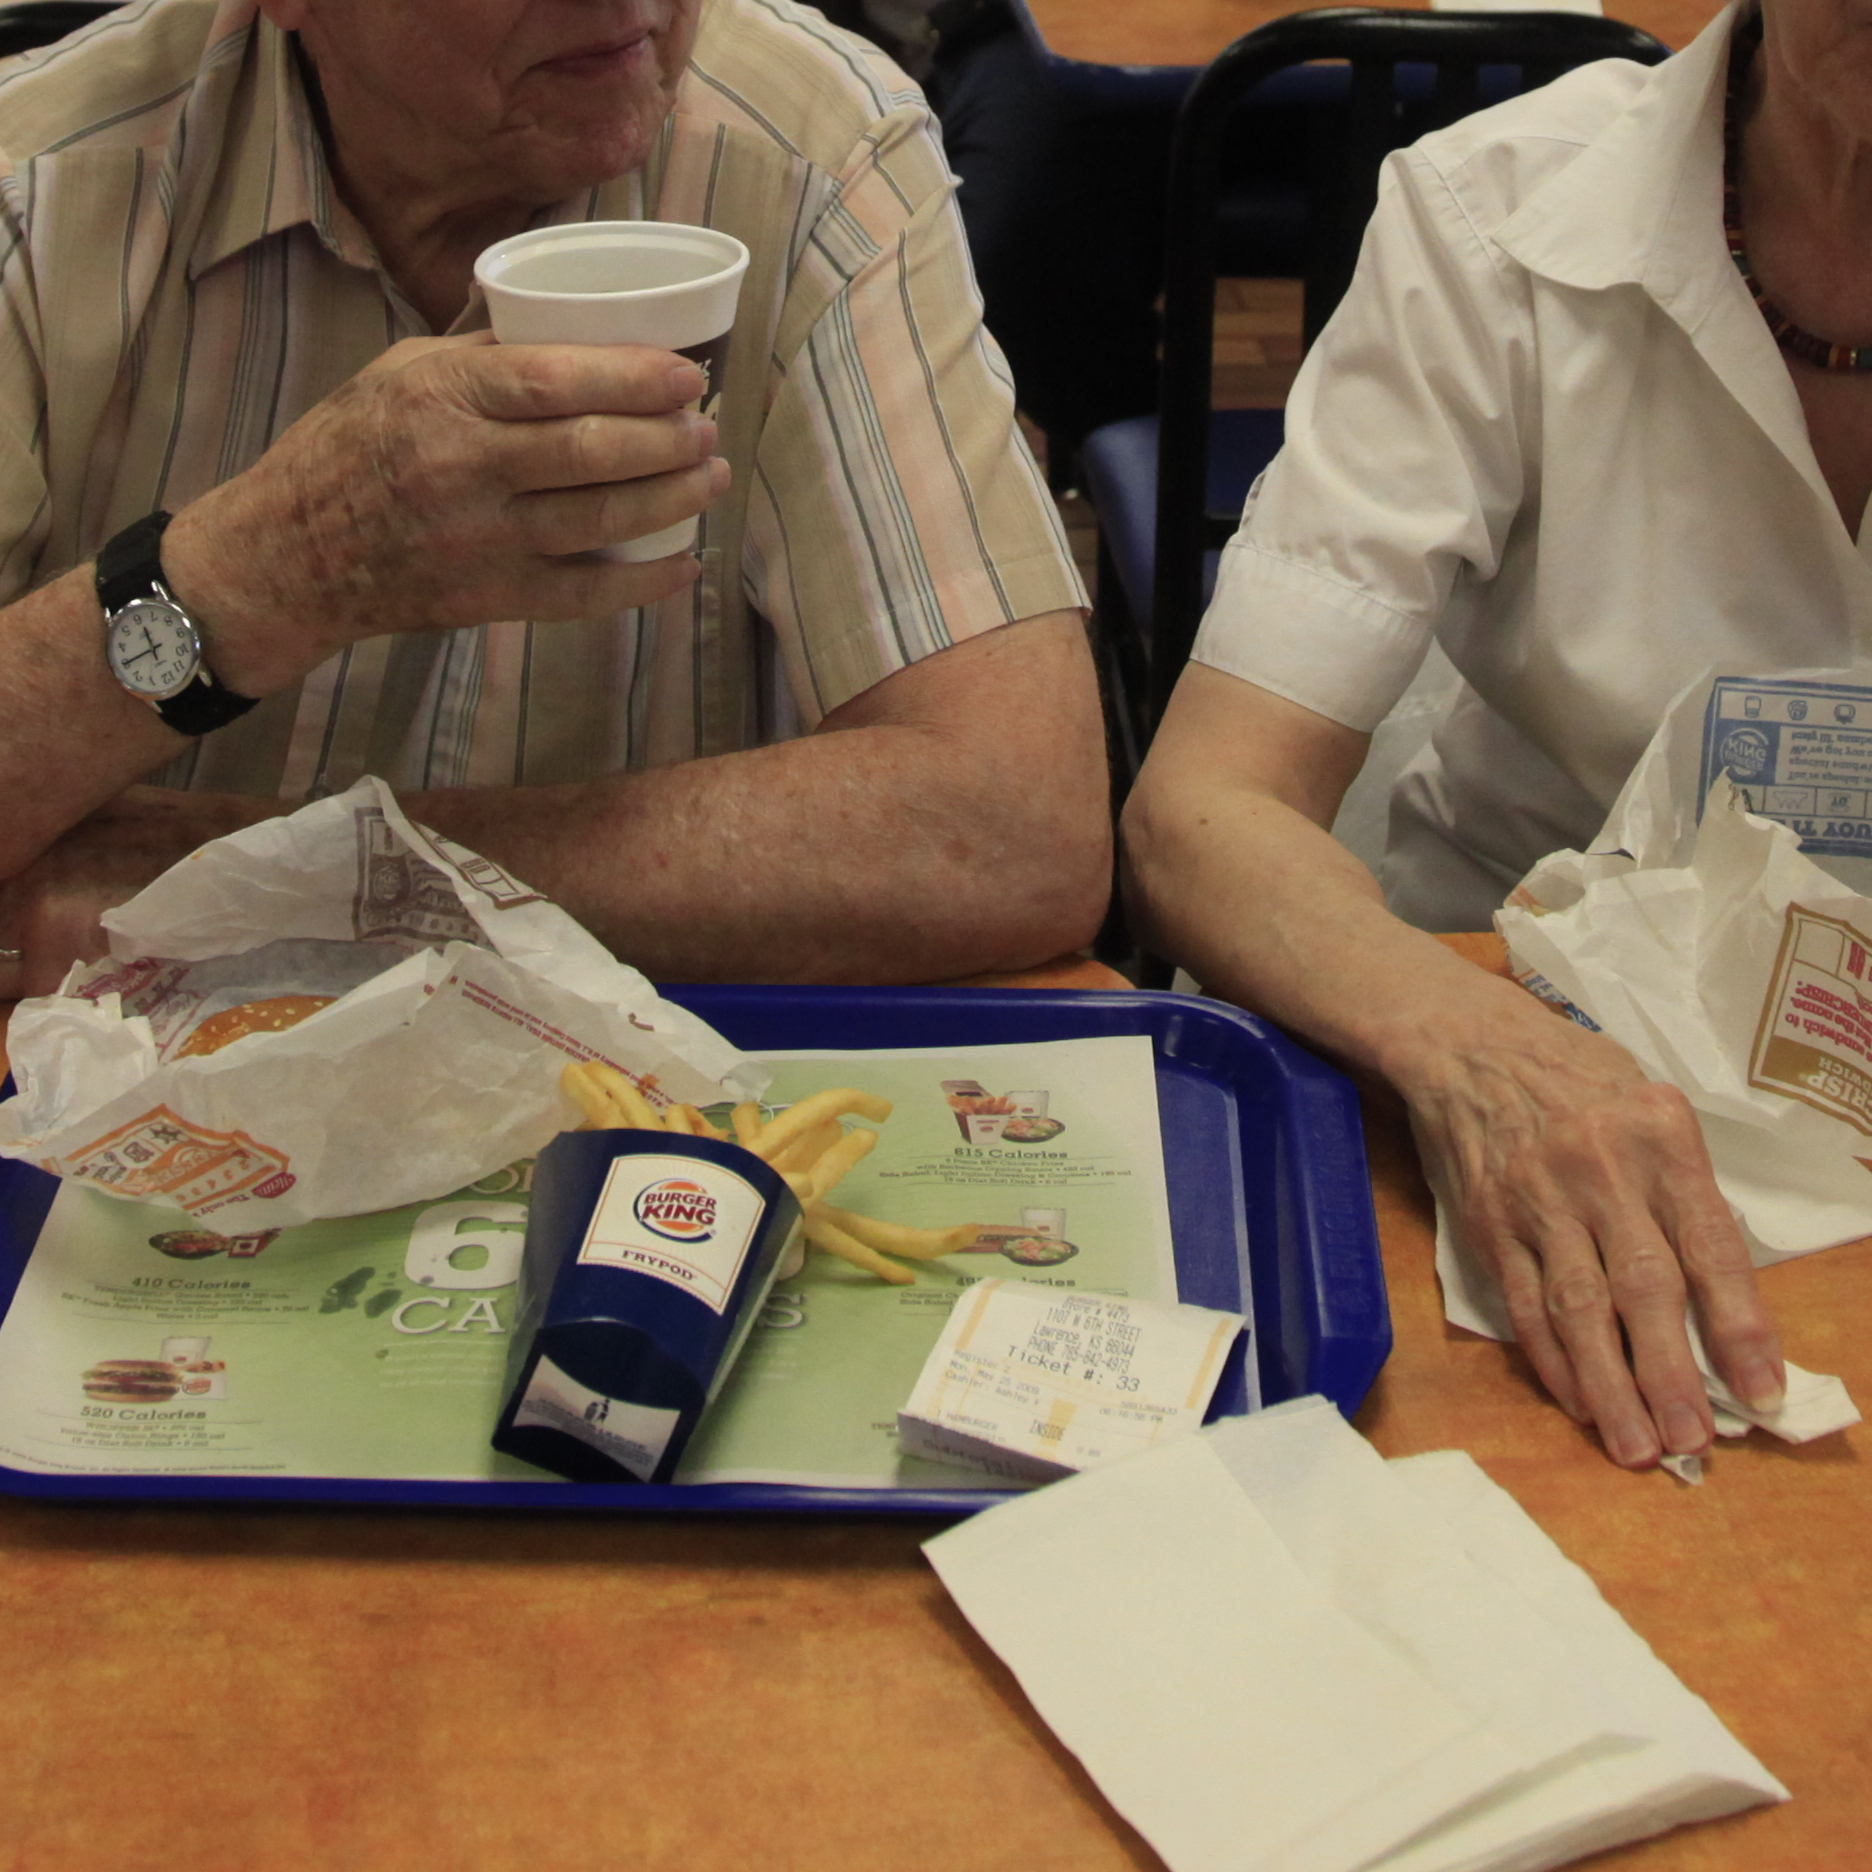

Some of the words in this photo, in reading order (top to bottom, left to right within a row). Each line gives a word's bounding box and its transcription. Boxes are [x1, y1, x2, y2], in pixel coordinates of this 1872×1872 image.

[133, 614, 142, 625] 6
[150, 611, 158, 621] 7
[164, 615, 173, 626] 8
[122, 626, 131, 636] 5
[176, 627, 185, 638] 9
[118, 642, 127, 653] 4
[175, 643, 189, 656] 10
[172, 660, 185, 672] 11
[132, 671, 143, 682] 2
[160, 671, 175, 684] 12
[1785, 1013, 1799, 1028] to
[1834, 1014, 1854, 1034] the
[1803, 1019, 1864, 1056] sandwich
[989, 1148, 1068, 1159] Calories
[225, 1189, 249, 1209] The
[644, 1192, 717, 1210] BURGER
[198, 1197, 225, 1218] only
[642, 1204, 716, 1225] KING
[622, 1250, 695, 1280] FRYPOD
[130, 1276, 162, 1288] 410
[167, 1276, 251, 1292] Calories
[1107, 1307, 1130, 1323] 4473
[1047, 1307, 1070, 1324] 1107
[1083, 1316, 1104, 1331] 6TH
[1105, 1321, 1142, 1342] STREET
[1028, 1336, 1058, 1356] PHONE
[1089, 1334, 1104, 1349] KS
[978, 1369, 994, 1381] May
[1007, 1345, 1072, 1376] Ticket
[1083, 1369, 1104, 1385] #:
[1115, 1375, 1141, 1392] 33
[945, 1370, 991, 1390] Cashier:
[80, 1405, 113, 1418] 520
[118, 1406, 206, 1423] Calories
[1029, 1419, 1066, 1441] INSIDE
